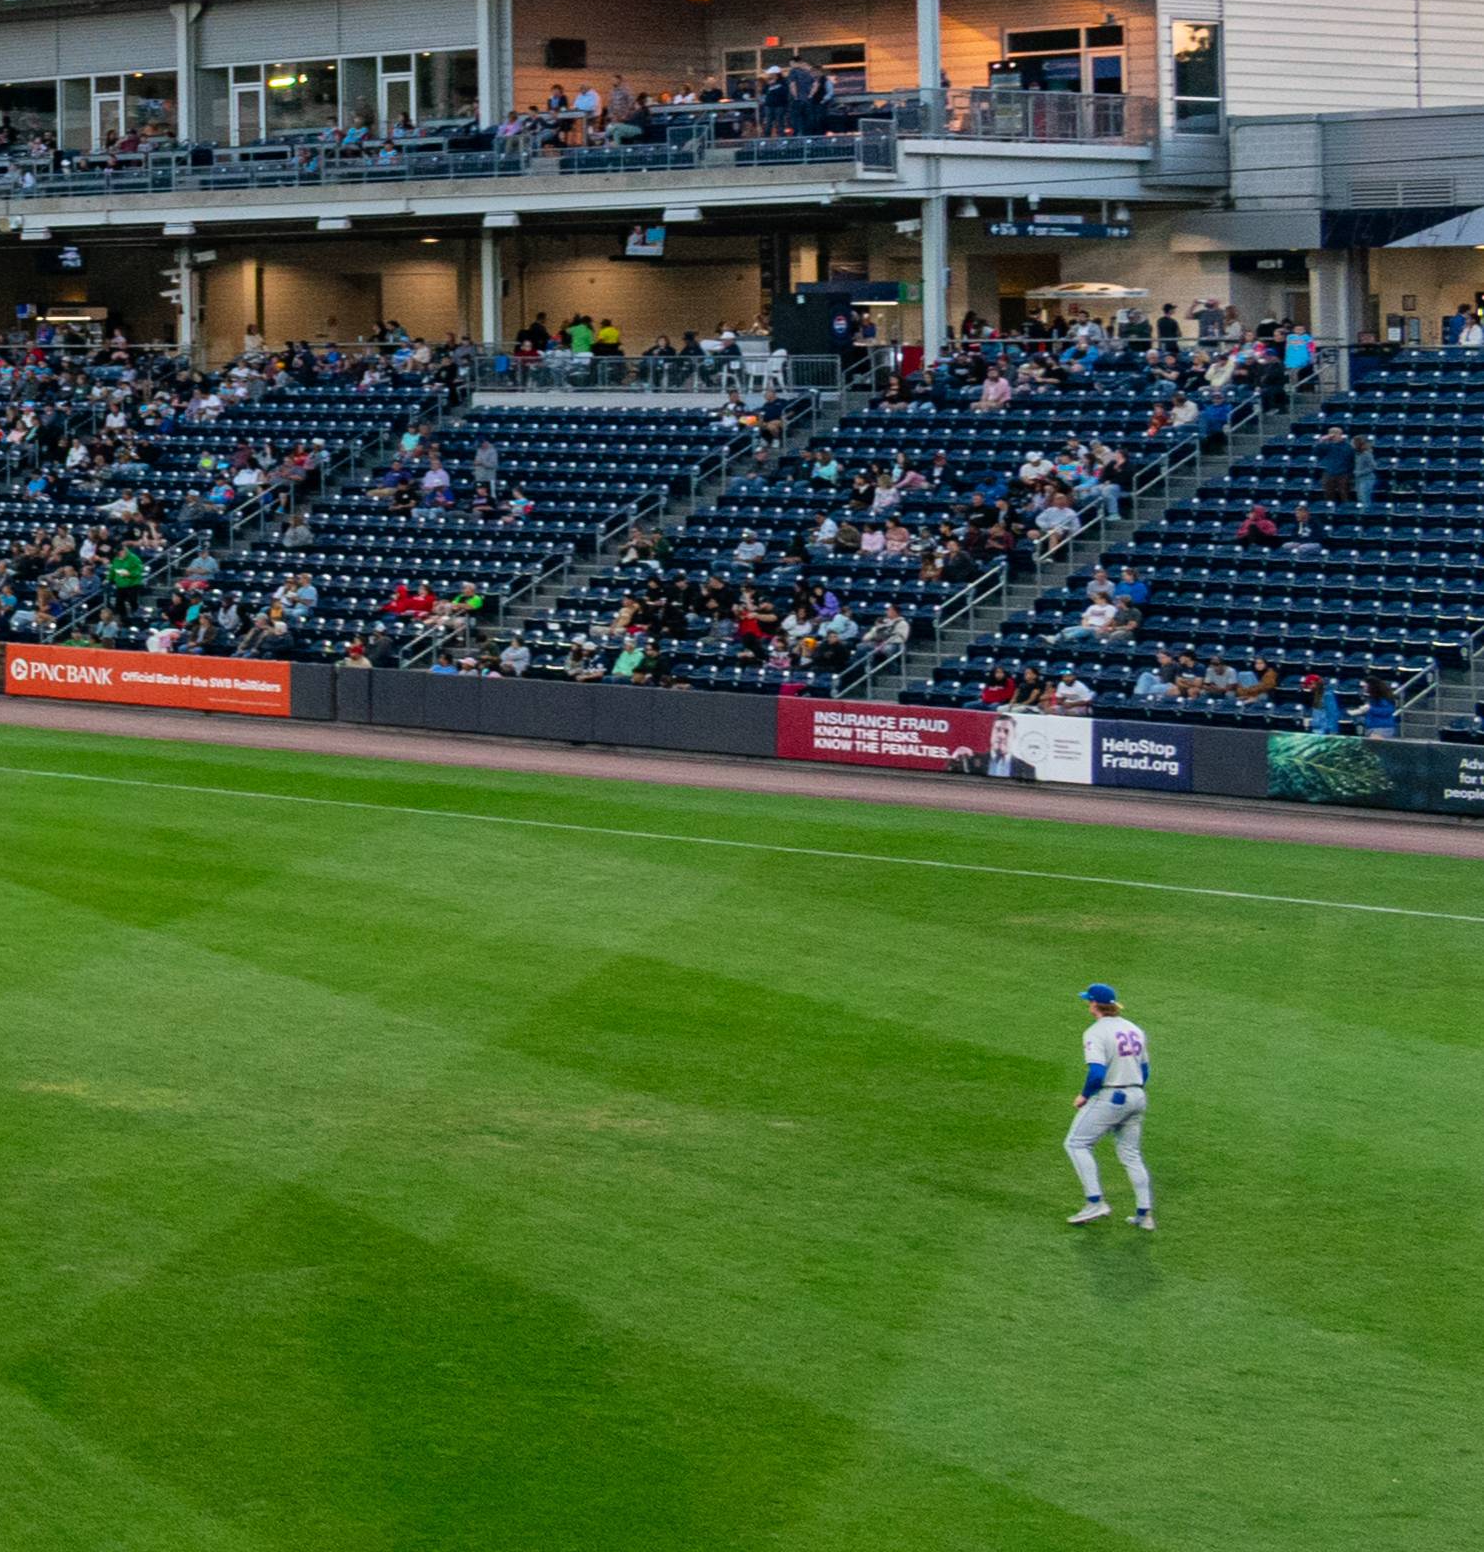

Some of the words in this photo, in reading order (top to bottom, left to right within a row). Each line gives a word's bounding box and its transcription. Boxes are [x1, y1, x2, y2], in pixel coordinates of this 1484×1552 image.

[30, 661, 65, 682] PNC
[66, 665, 113, 685] BANK
[121, 671, 155, 683] Official
[156, 673, 179, 685] Bank
[181, 675, 191, 685] of
[193, 676, 208, 687] the
[814, 711, 897, 730] INSURANCE
[898, 716, 950, 733] FRAUD
[813, 725, 852, 739] KNOW
[855, 728, 879, 741] THE
[881, 731, 922, 744] RISKS.
[813, 737, 852, 751] KNOW
[855, 740, 879, 754] THE
[881, 742, 952, 759] PENALTIES.
[1101, 737, 1177, 758] HelpStop
[1101, 754, 1179, 776] Fraud.org
